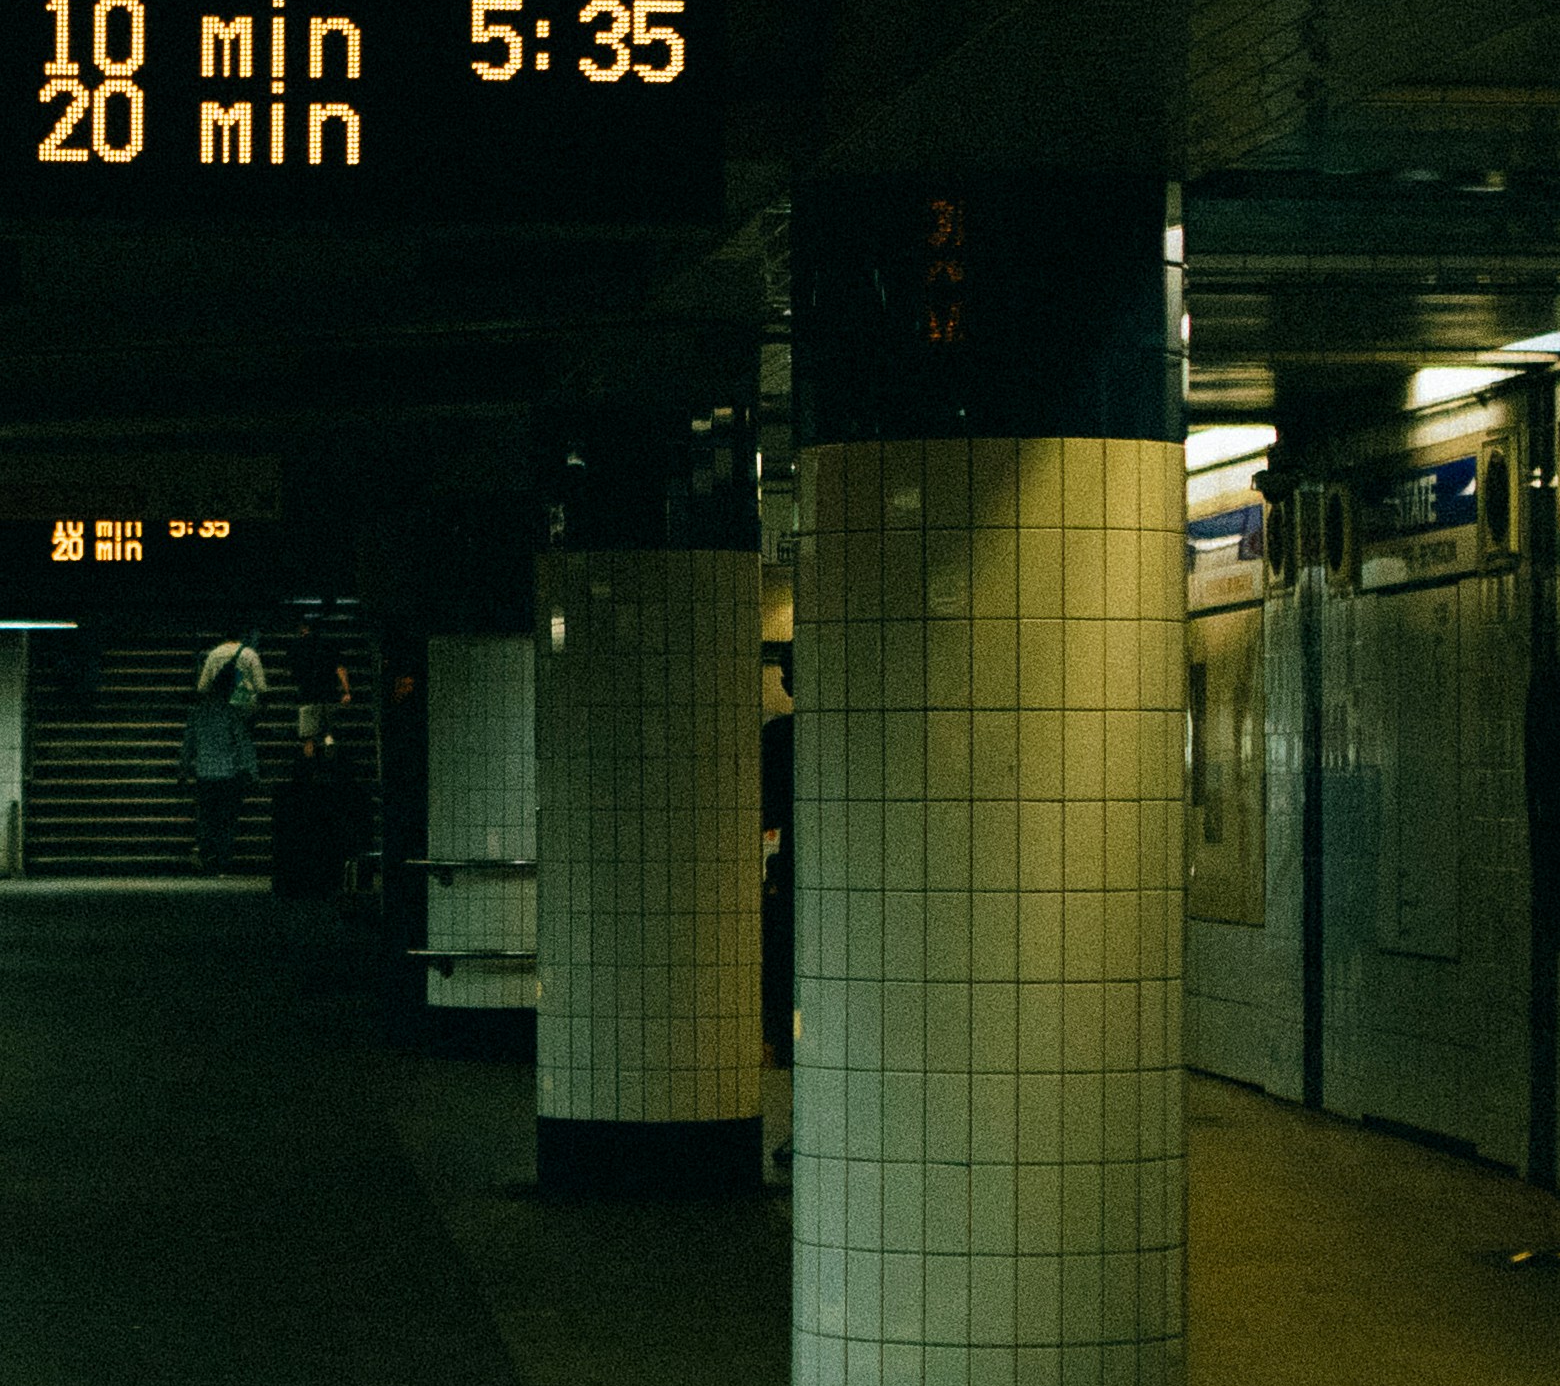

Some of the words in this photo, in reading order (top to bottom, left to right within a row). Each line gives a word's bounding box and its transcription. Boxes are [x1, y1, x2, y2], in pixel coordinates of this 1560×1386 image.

[38, 79, 145, 164] 20
[200, 80, 361, 166] min
[52, 536, 84, 562] 20
[95, 537, 143, 562] min
